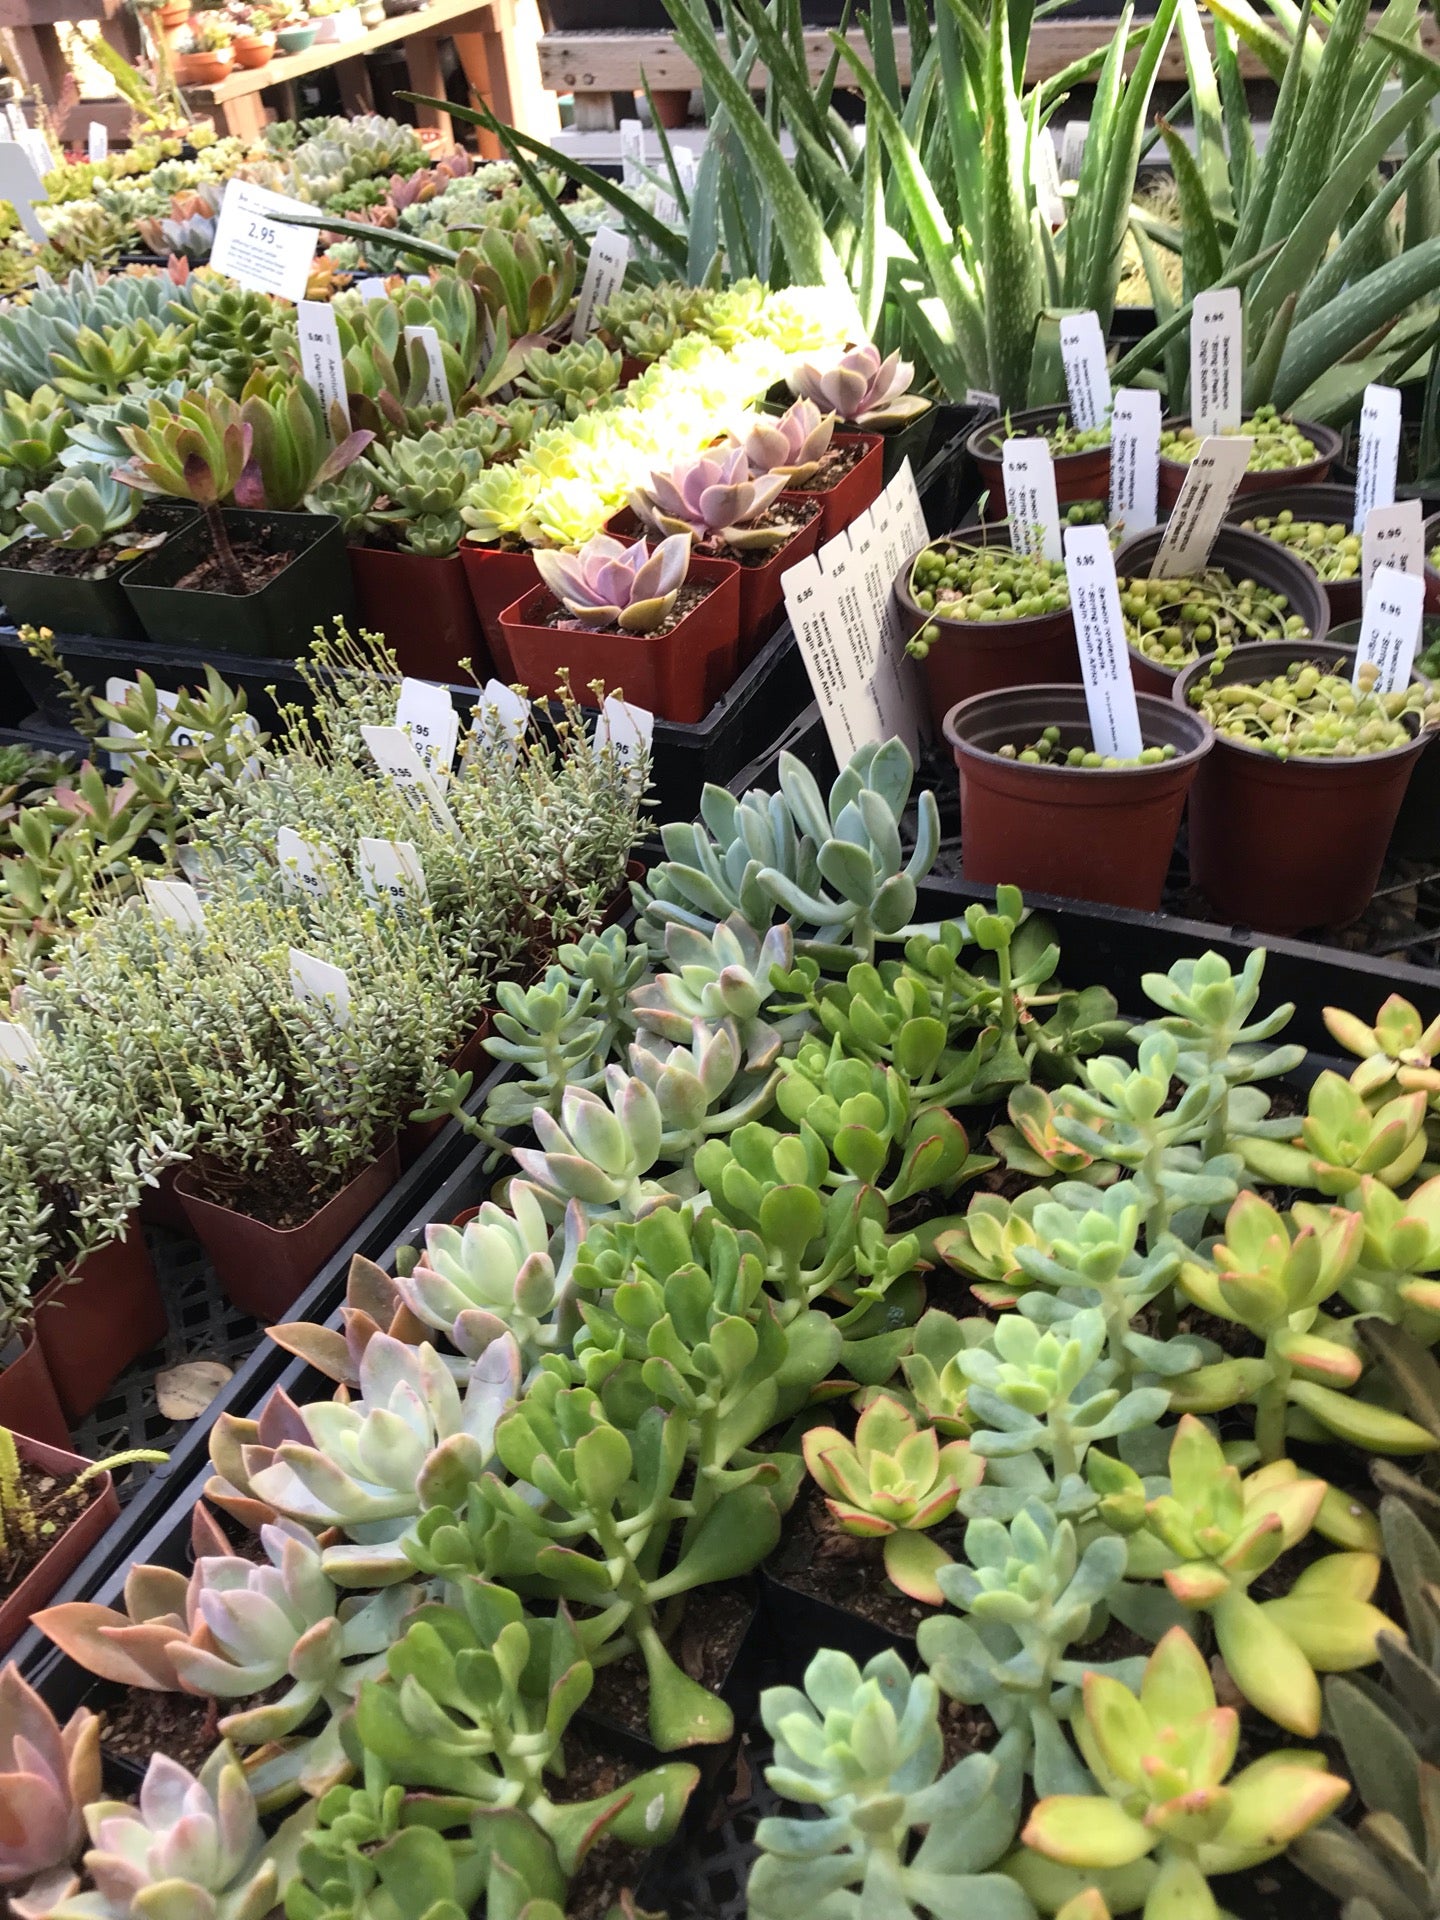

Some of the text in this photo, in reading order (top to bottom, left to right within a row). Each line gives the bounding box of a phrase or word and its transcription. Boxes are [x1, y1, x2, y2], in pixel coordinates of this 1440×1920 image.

[248, 222, 276, 244] 2.95
[801, 621, 833, 707] Origin: South Africa
[811, 619, 823, 647] String
[820, 648, 828, 657] of
[824, 658, 836, 686] Pearls
[819, 610, 846, 689] Senecio rowleyanus
[836, 596, 864, 680] Origin: South Africa
[1077, 586, 1100, 687] Origin: South Africa
[1087, 590, 1098, 622] String
[1094, 637, 1107, 669] Pearls
